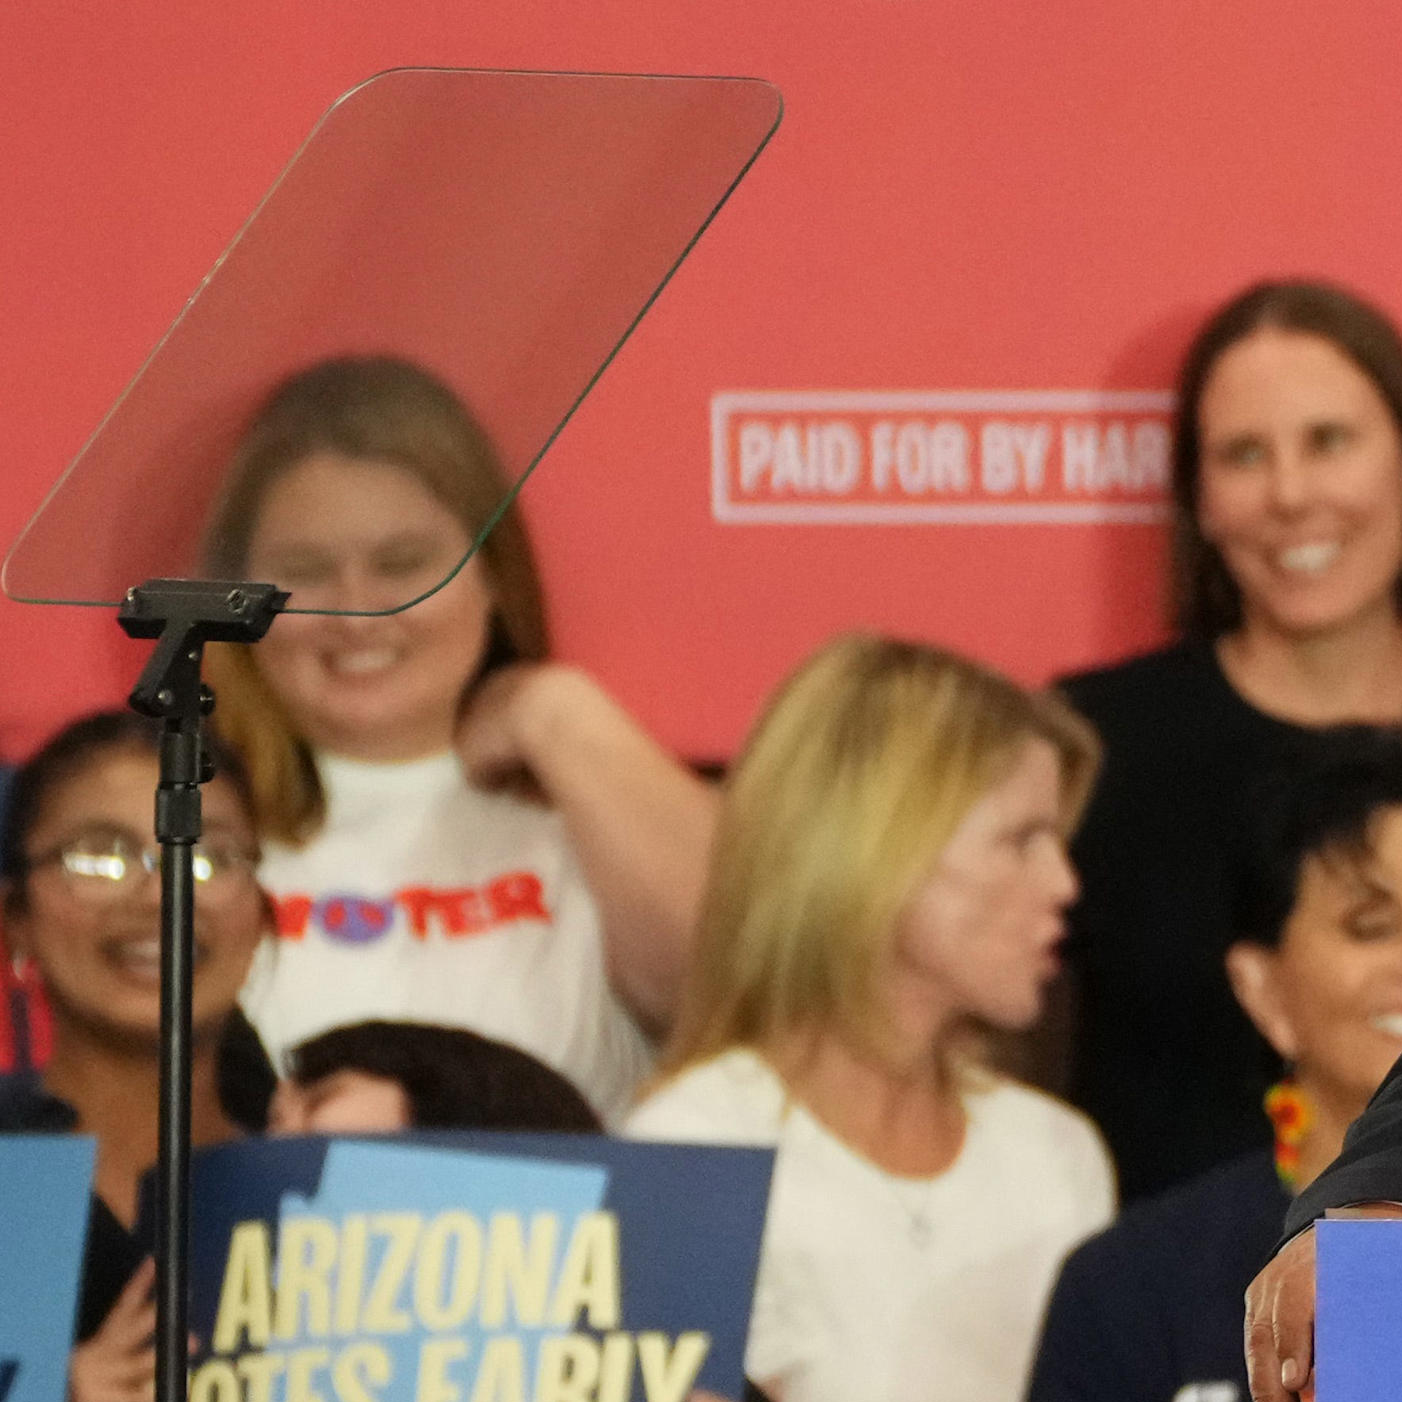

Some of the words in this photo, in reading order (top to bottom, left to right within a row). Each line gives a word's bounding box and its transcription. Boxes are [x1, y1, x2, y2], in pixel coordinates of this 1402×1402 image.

[740, 419, 861, 494] PAID
[871, 419, 969, 494] FOR
[980, 419, 1052, 494] BY
[1061, 419, 1174, 494] HAR
[212, 1208, 623, 1352] ARIZONA
